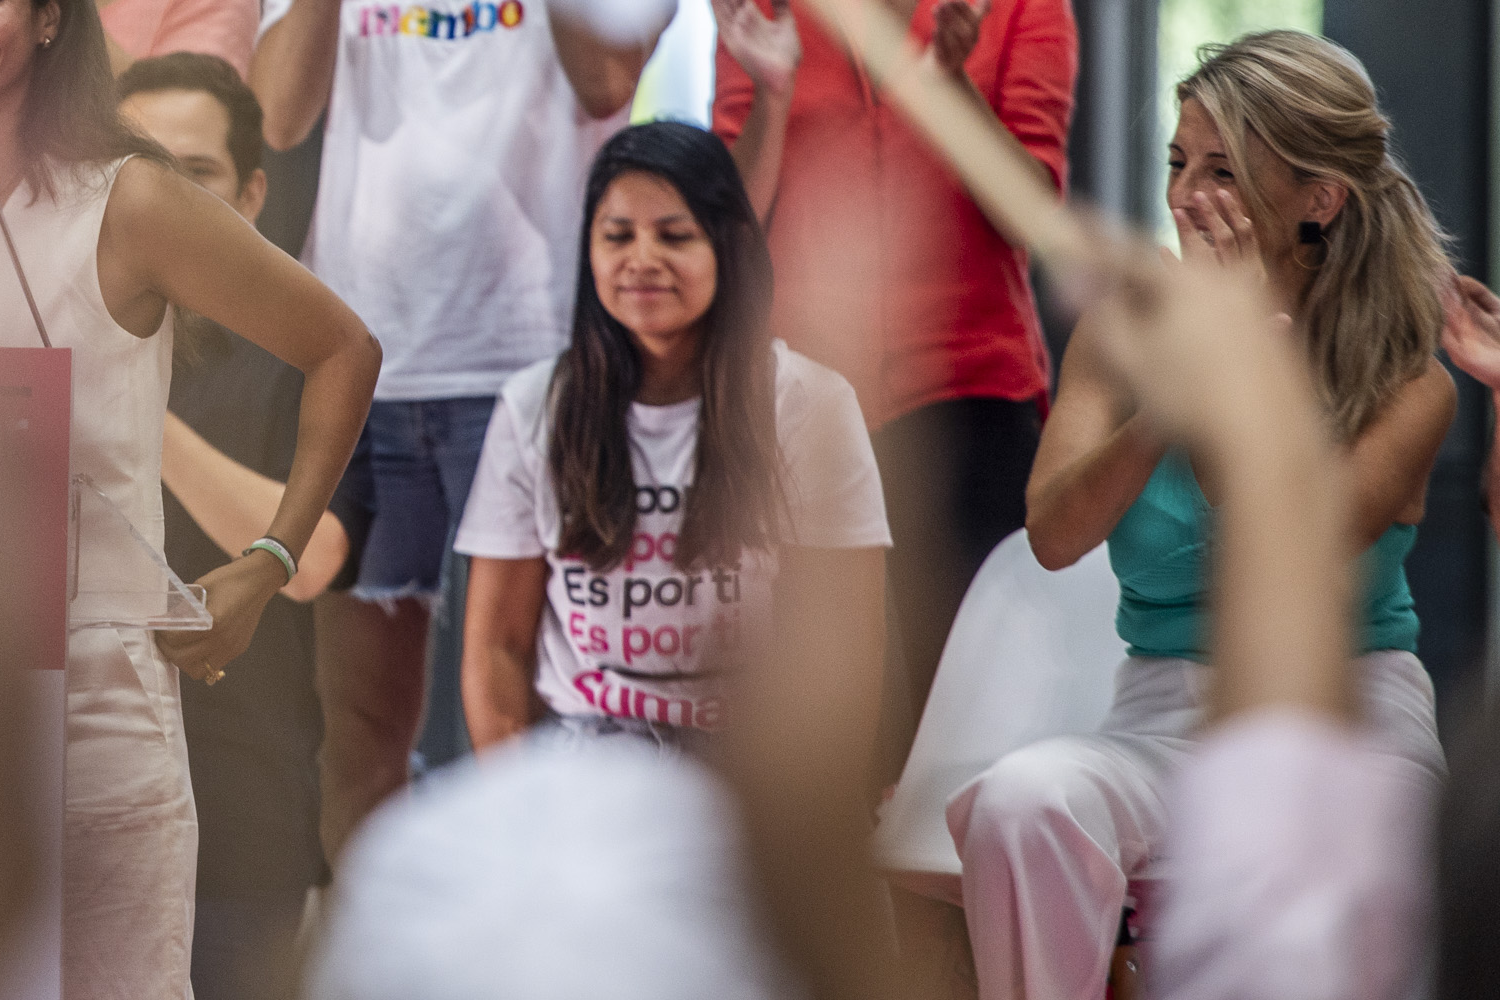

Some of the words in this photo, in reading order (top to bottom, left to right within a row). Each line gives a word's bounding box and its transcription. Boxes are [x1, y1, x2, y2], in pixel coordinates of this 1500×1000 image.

[563, 567, 609, 606] Es
[622, 577, 703, 619] por
[711, 564, 741, 605] ti
[569, 612, 609, 656] Es
[622, 624, 703, 665] por
